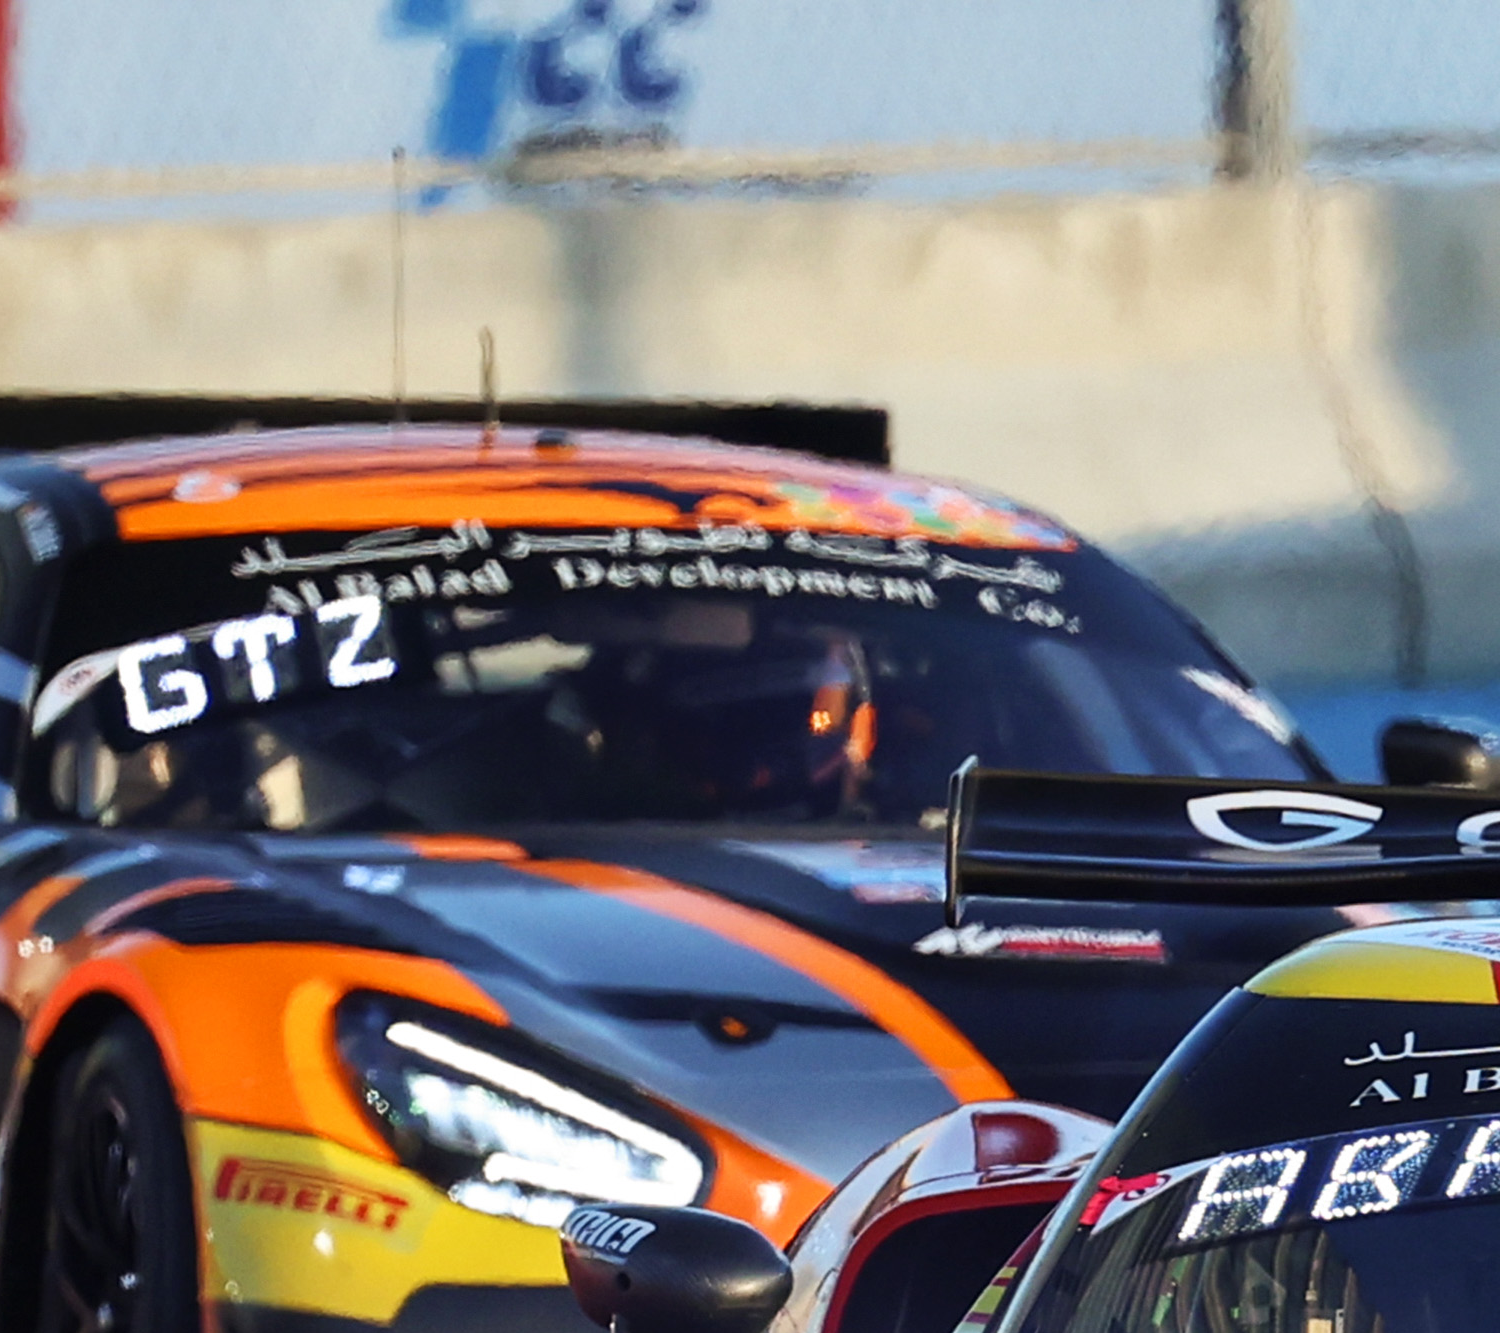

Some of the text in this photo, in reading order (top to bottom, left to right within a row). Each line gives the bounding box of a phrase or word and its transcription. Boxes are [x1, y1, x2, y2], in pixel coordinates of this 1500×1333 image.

[335, 559, 513, 600] Balad
[552, 555, 939, 609] Development
[1350, 1073, 1429, 1107] Al
[215, 1158, 409, 1230] PIRELLI
